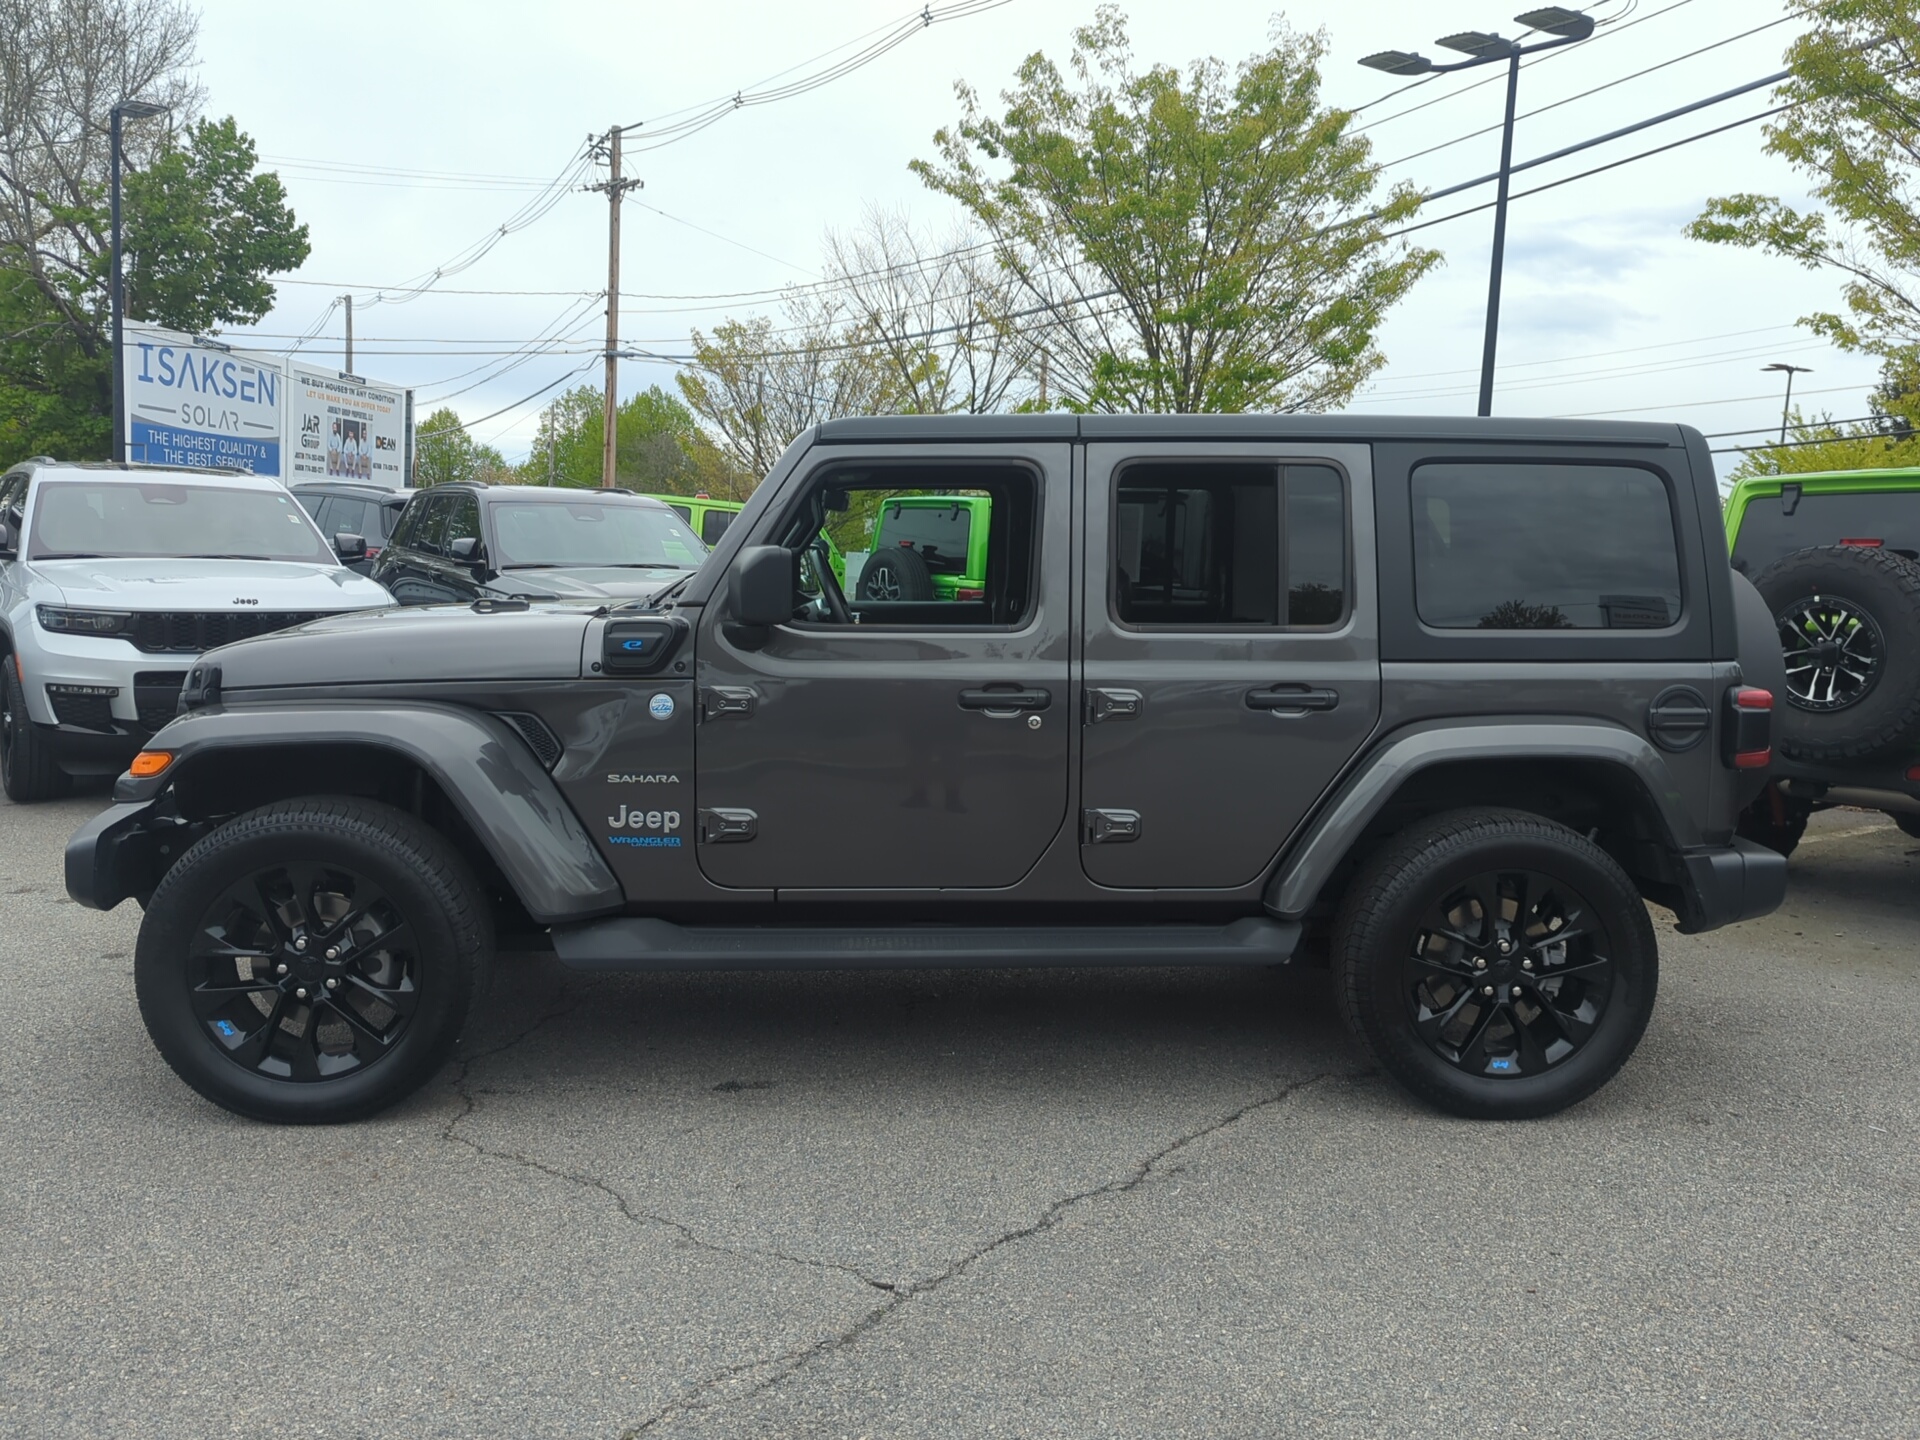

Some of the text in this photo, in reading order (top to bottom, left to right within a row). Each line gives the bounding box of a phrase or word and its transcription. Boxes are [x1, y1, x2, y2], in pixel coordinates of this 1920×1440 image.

[138, 342, 275, 407] ISAKSEN
[301, 376, 310, 386] WE
[311, 379, 324, 388] BUY
[325, 382, 348, 394] HOUSES
[356, 389, 367, 398] ANY
[367, 392, 396, 405] CONDITION
[306, 390, 316, 398] LET
[181, 403, 239, 432] SOLAR
[301, 413, 320, 434] JAR
[148, 430, 267, 458] THE HIGHEST QUALITY &
[301, 434, 320, 449] GROUP
[375, 436, 396, 451] DEAN
[164, 449, 254, 473] THE BEST SERVICE
[232, 597, 259, 606] Jeep
[607, 774, 680, 783] SAHARA
[608, 805, 681, 833] Jeep
[608, 836, 681, 844] WRANGLER
